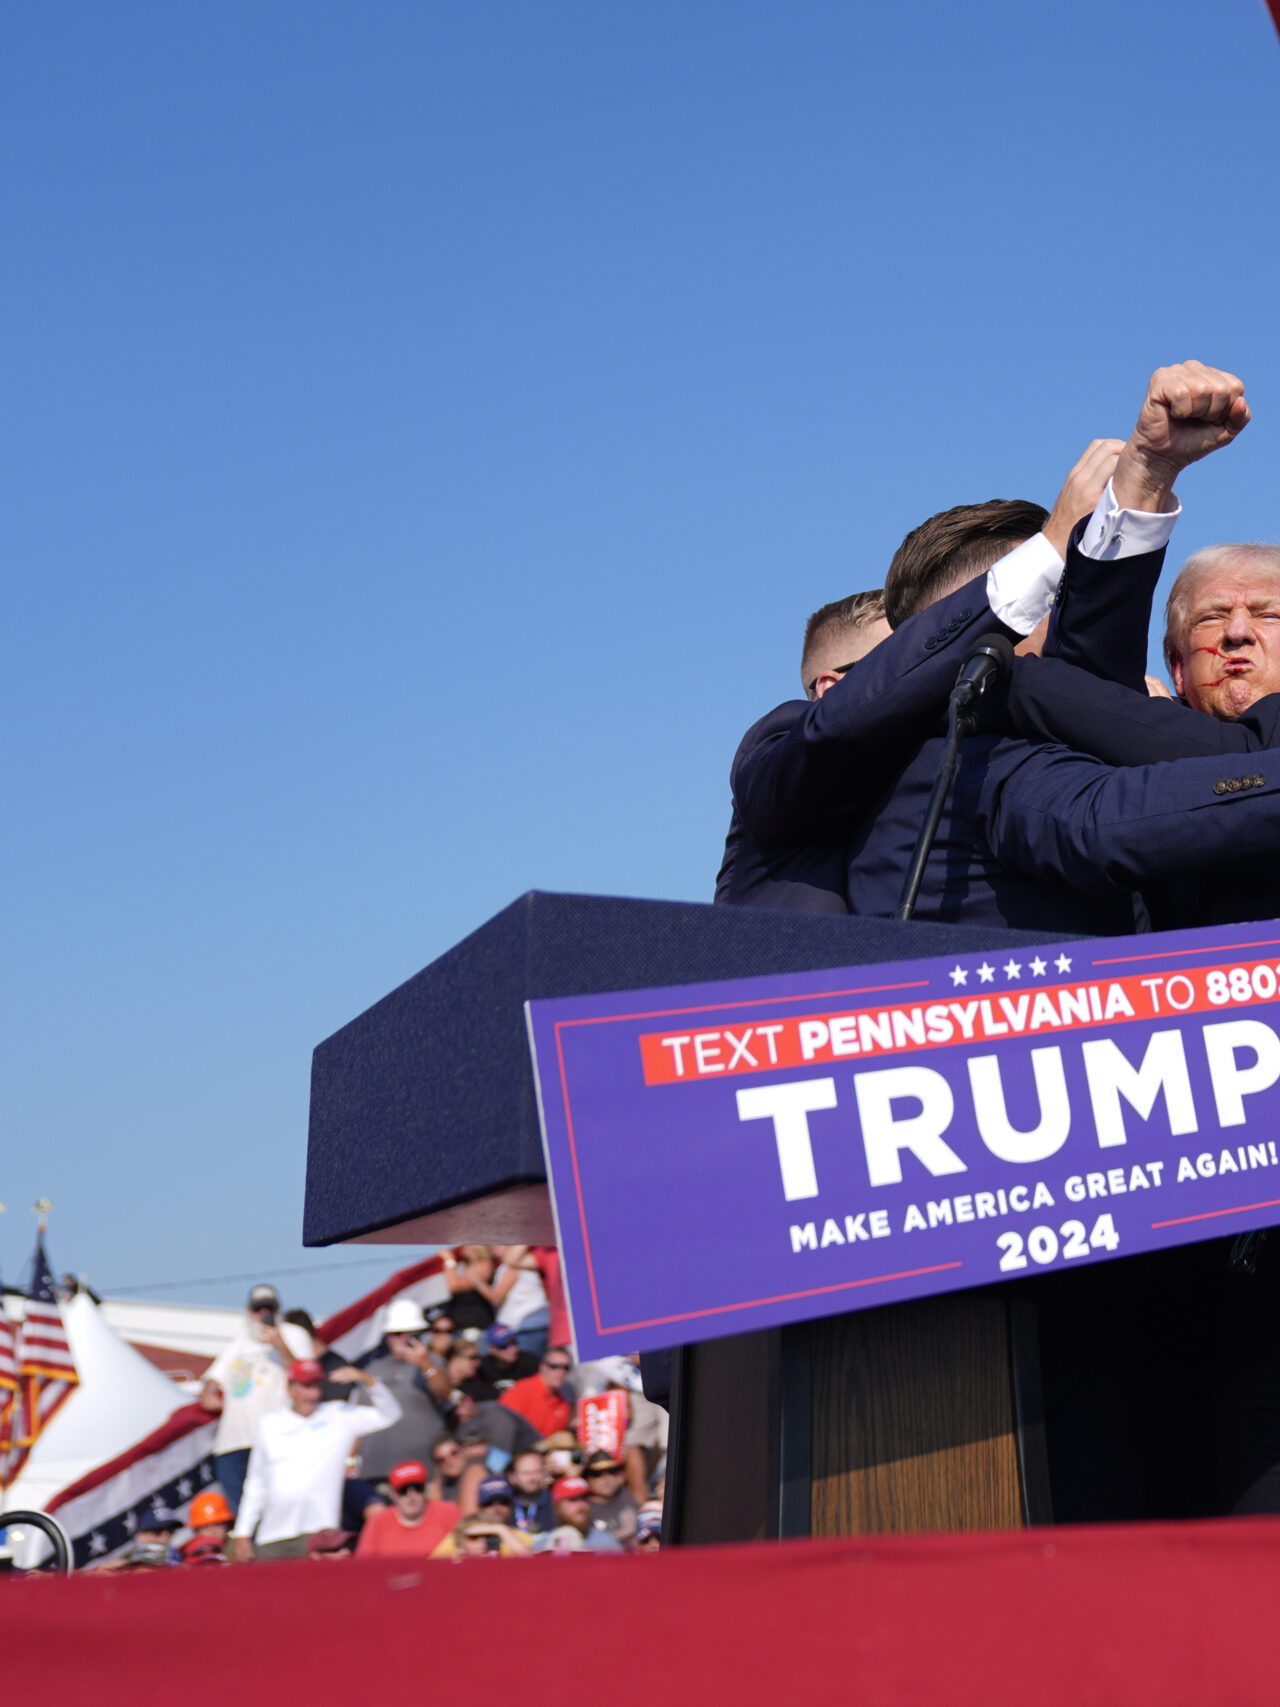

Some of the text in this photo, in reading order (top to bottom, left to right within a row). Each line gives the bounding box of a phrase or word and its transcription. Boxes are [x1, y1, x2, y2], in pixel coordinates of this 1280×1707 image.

[661, 1024, 784, 1076] TEXT
[798, 983, 1135, 1060] PENNSYLVANIA
[1140, 975, 1195, 1013] TO
[789, 1141, 1279, 1253] MAKE AMERICA GREAT AGAIN!
[996, 1213, 1120, 1272] 2024
